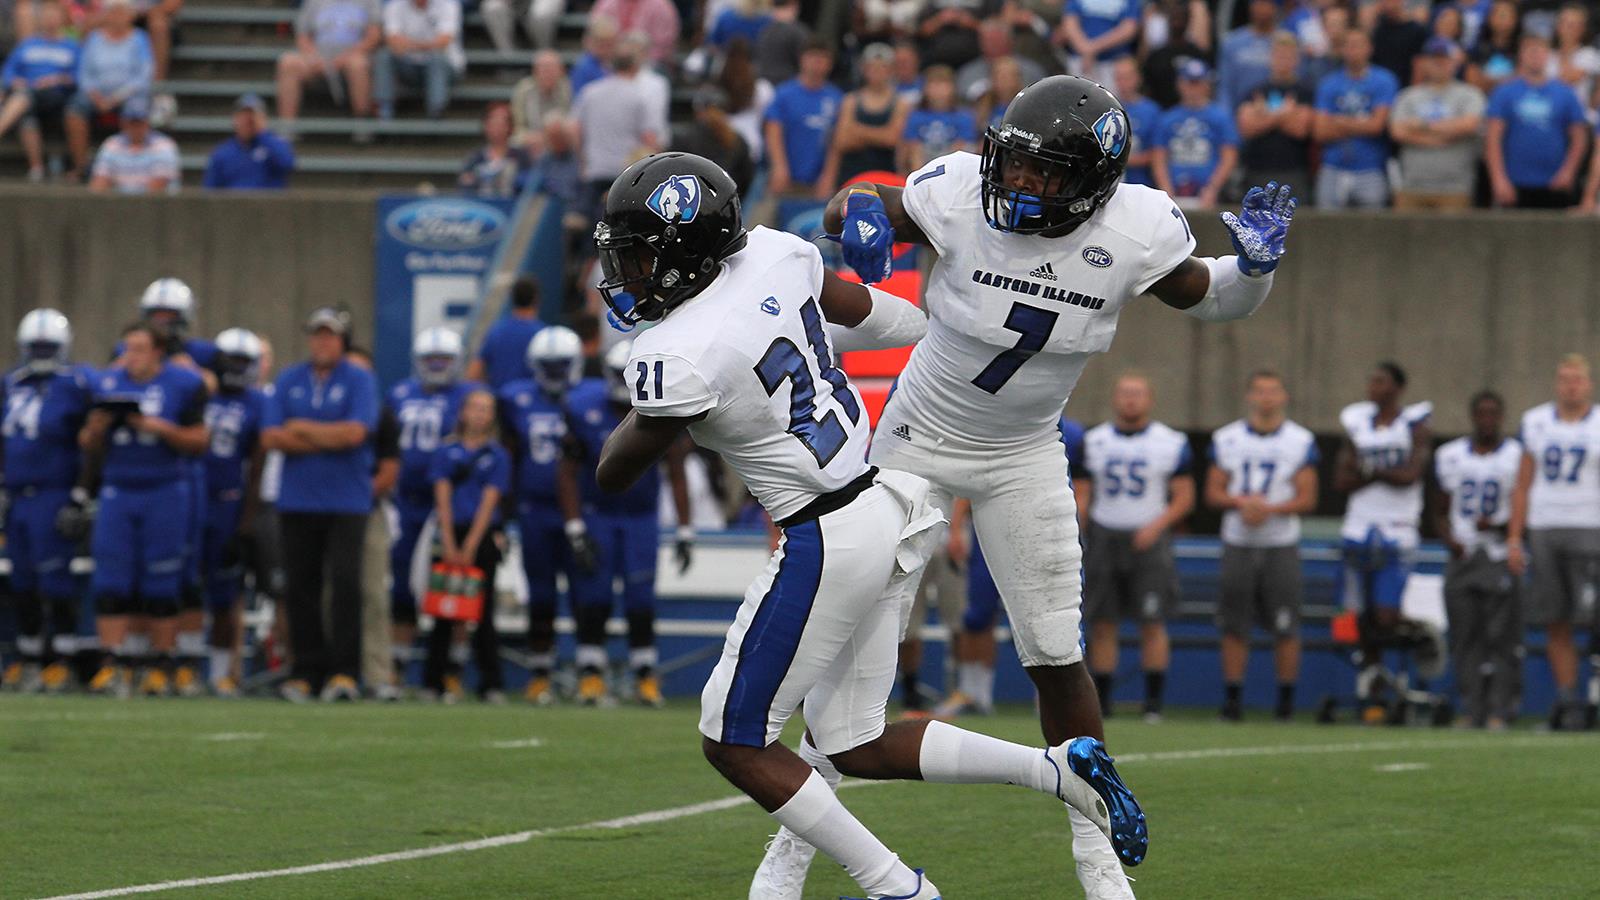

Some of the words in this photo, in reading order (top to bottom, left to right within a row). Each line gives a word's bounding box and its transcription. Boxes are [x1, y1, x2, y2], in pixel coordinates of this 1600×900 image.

[1029, 271, 1058, 281] adidas
[1086, 251, 1107, 264] OVC
[972, 269, 1042, 296] EASTERN
[1041, 285, 1106, 310] ILLINOIS
[971, 301, 1060, 395] 7
[636, 361, 663, 400] 21
[753, 296, 860, 469] 21
[1, 388, 43, 440] 74
[398, 399, 444, 451] 70
[1105, 459, 1147, 497] 55
[1241, 461, 1276, 495] 17
[1544, 446, 1585, 483] 87
[1461, 480, 1499, 516] 28
